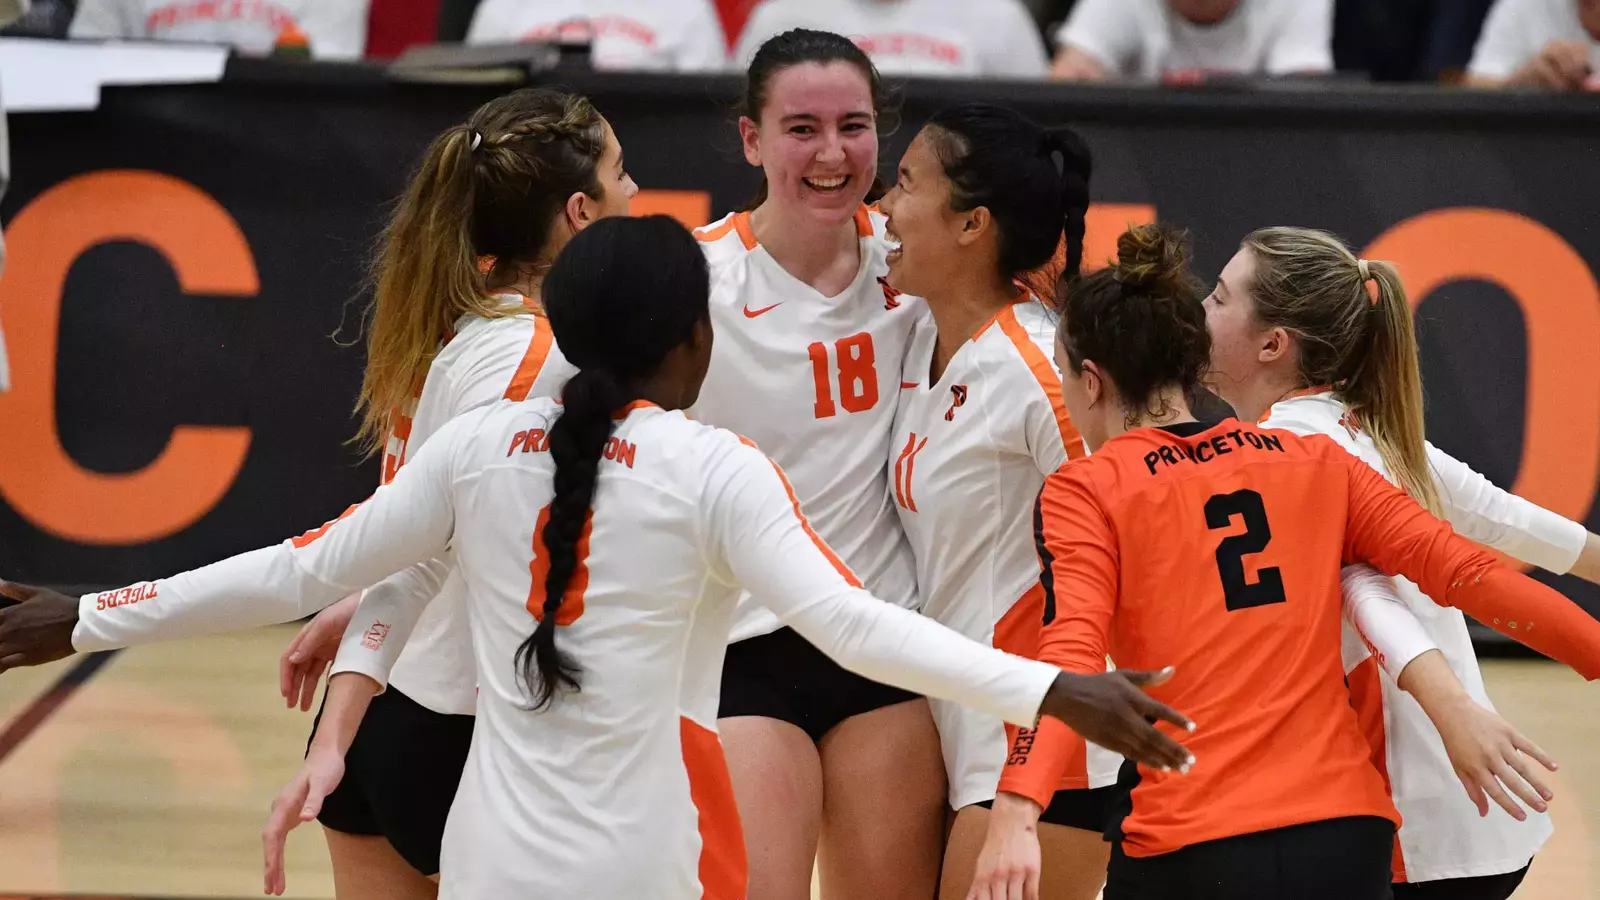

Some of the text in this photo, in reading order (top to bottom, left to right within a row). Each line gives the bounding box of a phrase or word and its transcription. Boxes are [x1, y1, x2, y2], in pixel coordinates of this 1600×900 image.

[807, 331, 879, 419] 18
[944, 384, 968, 422] P
[895, 432, 928, 513] 11
[1143, 428, 1285, 476] PRINCETON
[1203, 488, 1287, 612] 2
[96, 582, 158, 611] TIGERS
